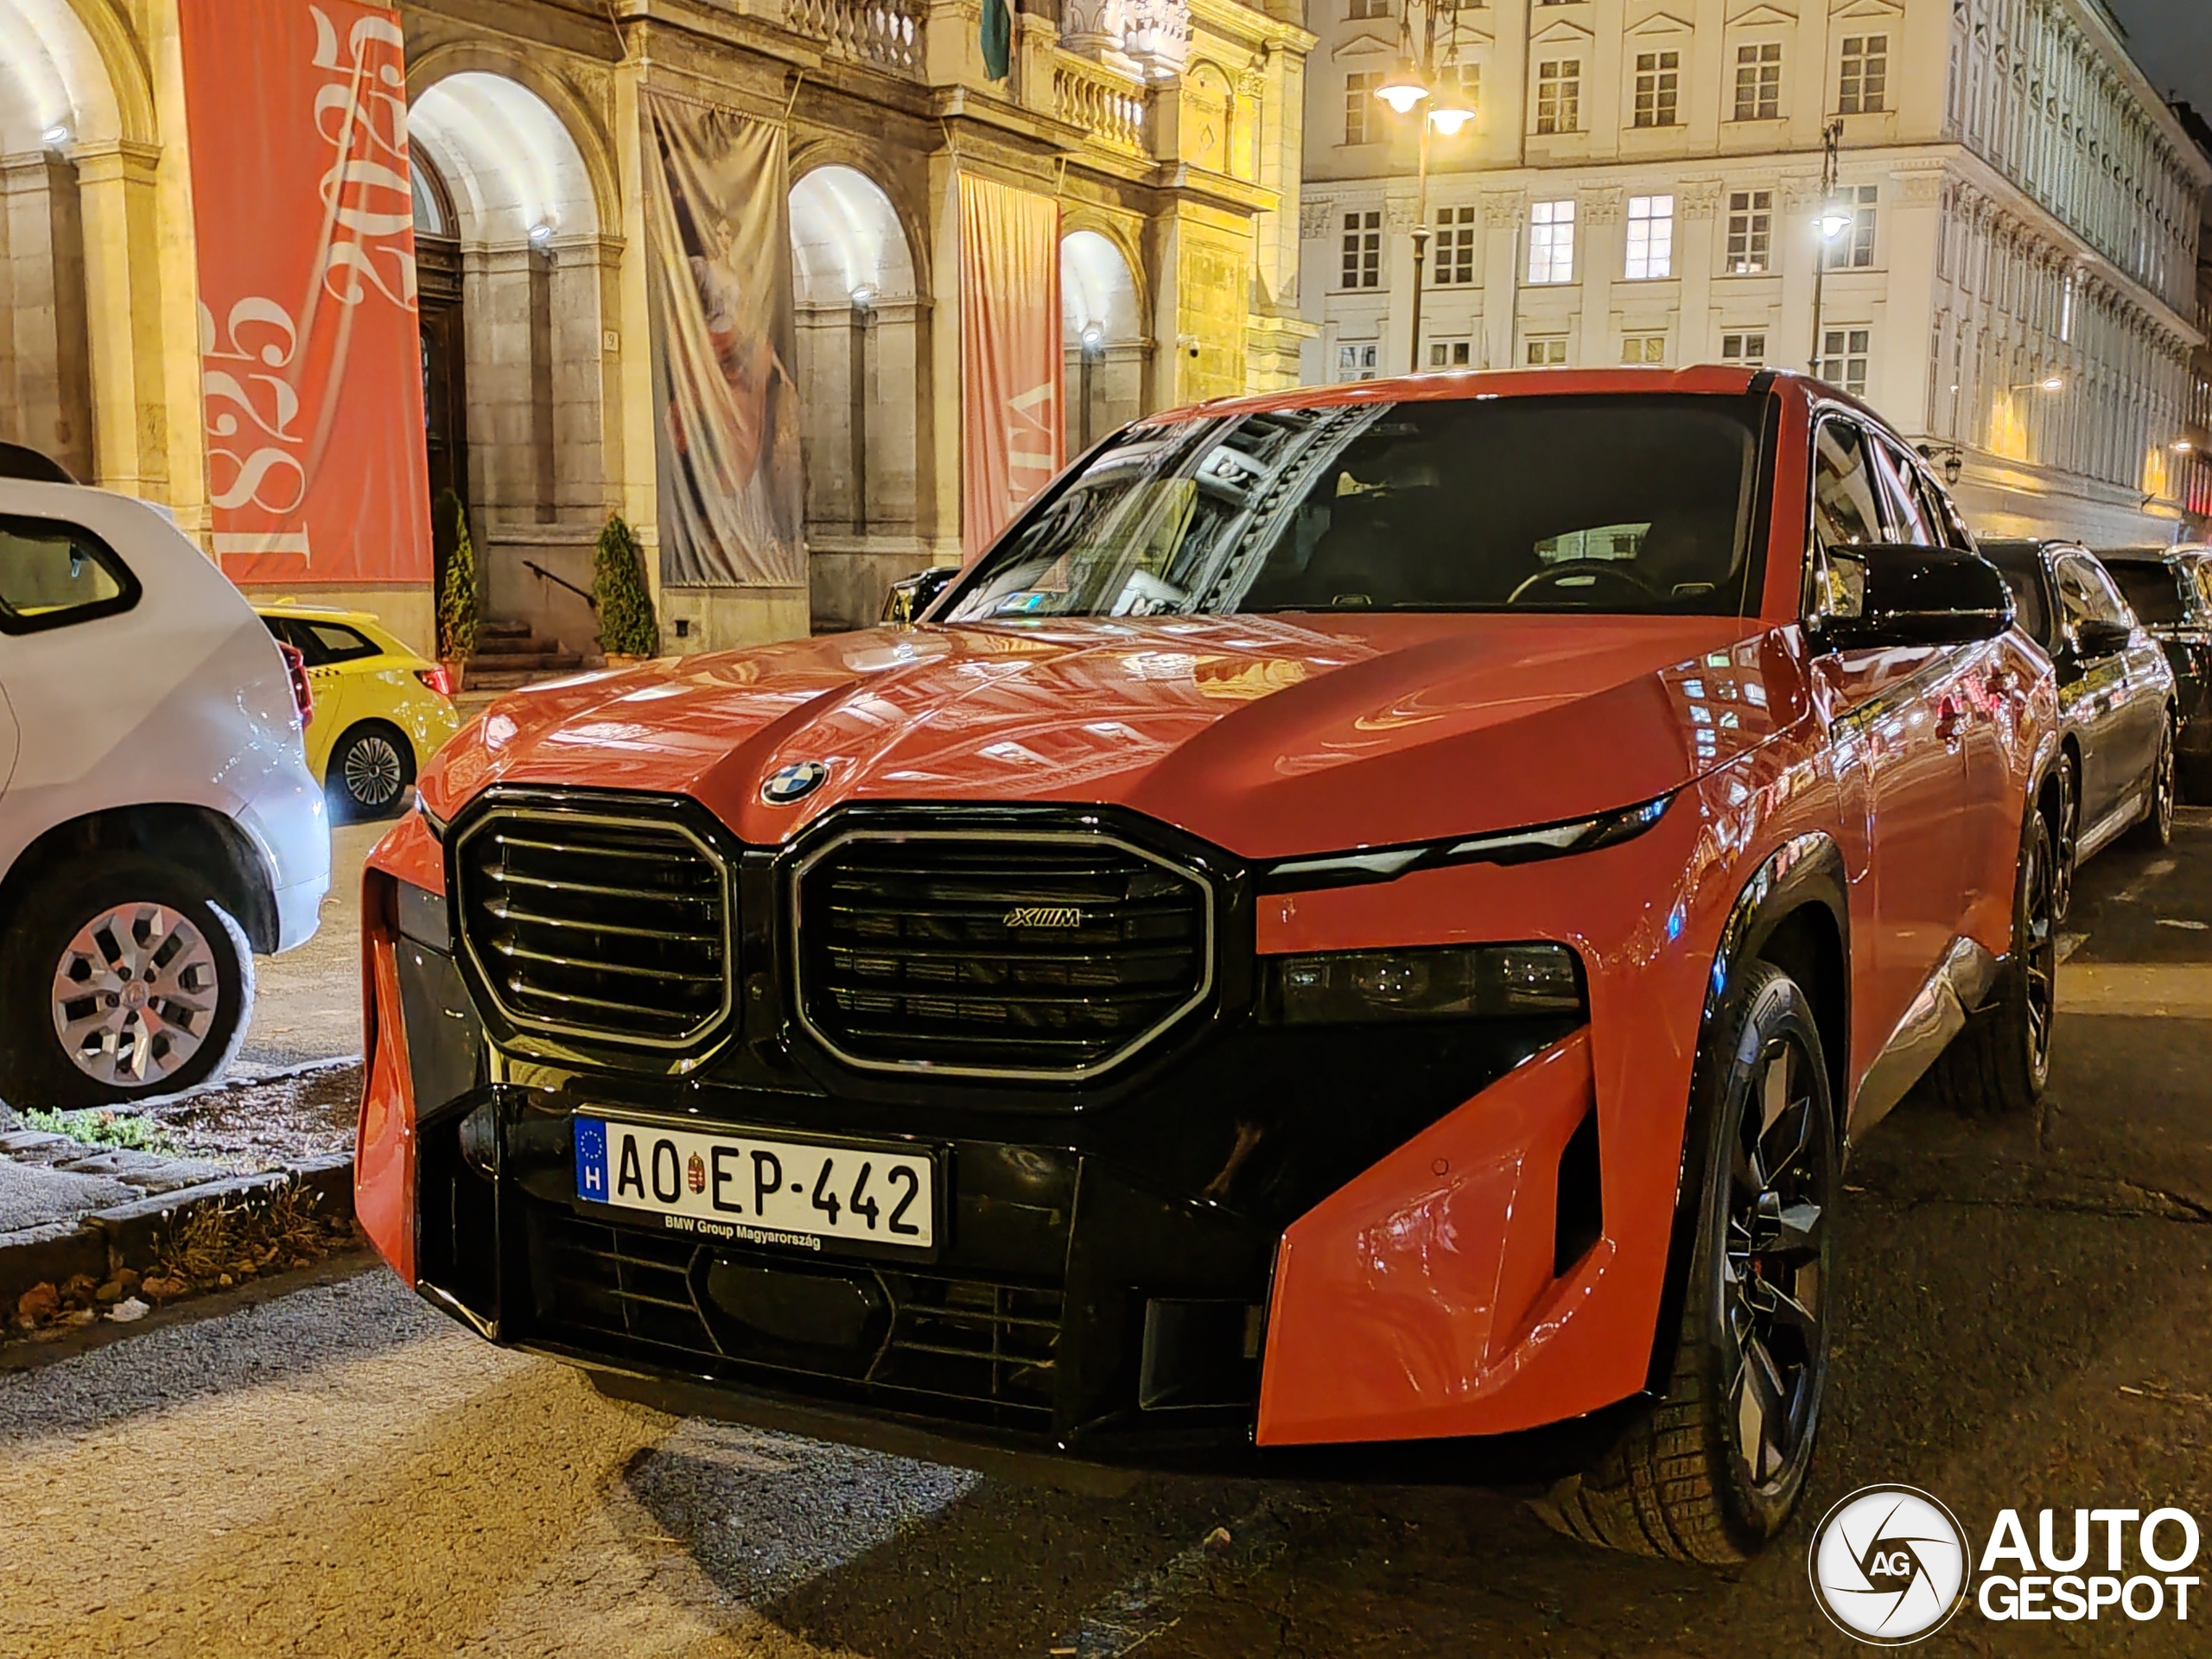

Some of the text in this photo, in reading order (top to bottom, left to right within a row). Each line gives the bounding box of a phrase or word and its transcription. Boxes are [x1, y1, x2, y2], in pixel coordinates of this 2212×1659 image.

[308, 4, 418, 313] 2025
[199, 296, 311, 574] 1825
[1007, 380, 1052, 518] TA
[585, 1165, 601, 1191] H
[664, 1215, 822, 1251] BMW Group Magyarország
[710, 1145, 920, 1236] EP-442
